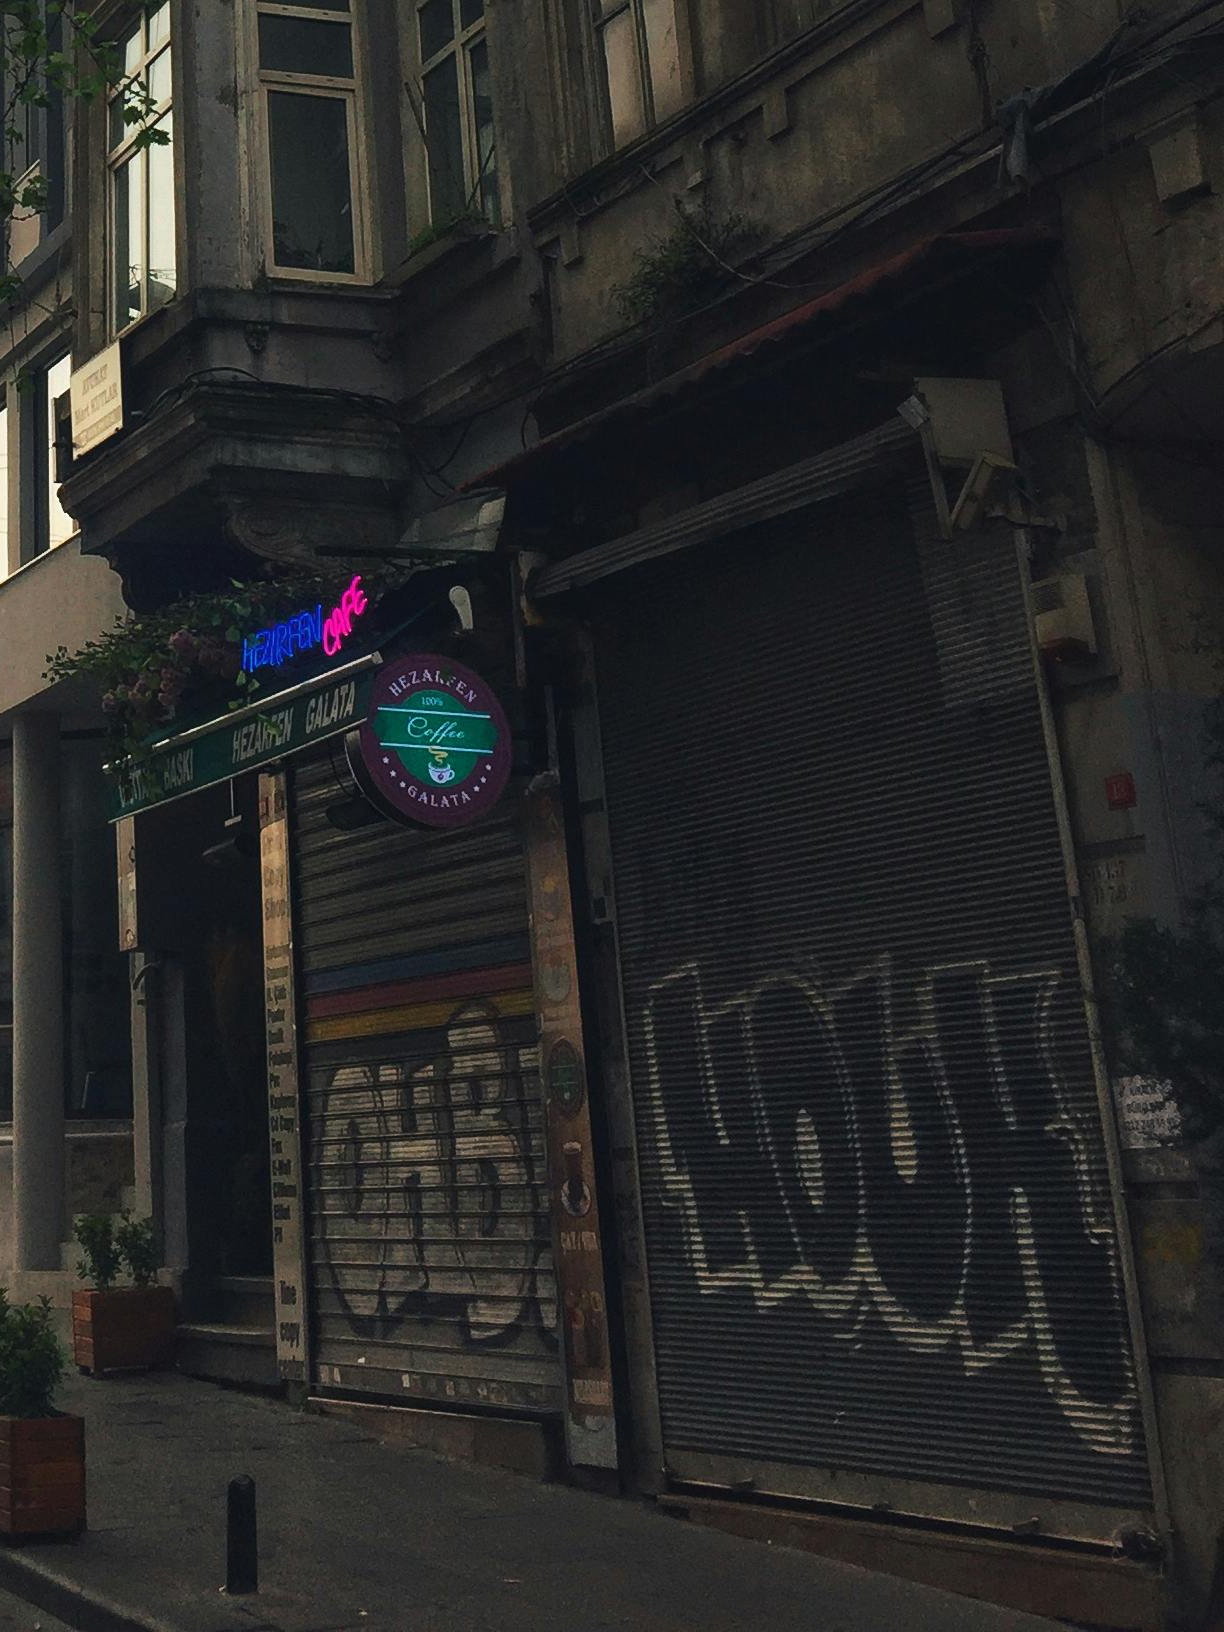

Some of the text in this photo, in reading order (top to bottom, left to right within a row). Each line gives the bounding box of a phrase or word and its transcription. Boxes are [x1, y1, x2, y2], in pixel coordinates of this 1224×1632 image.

[322, 572, 369, 657] CAFE
[305, 680, 357, 735] GALATA
[421, 696, 444, 707] 100%
[407, 715, 466, 744] Coffee
[407, 785, 472, 808] GALATA
